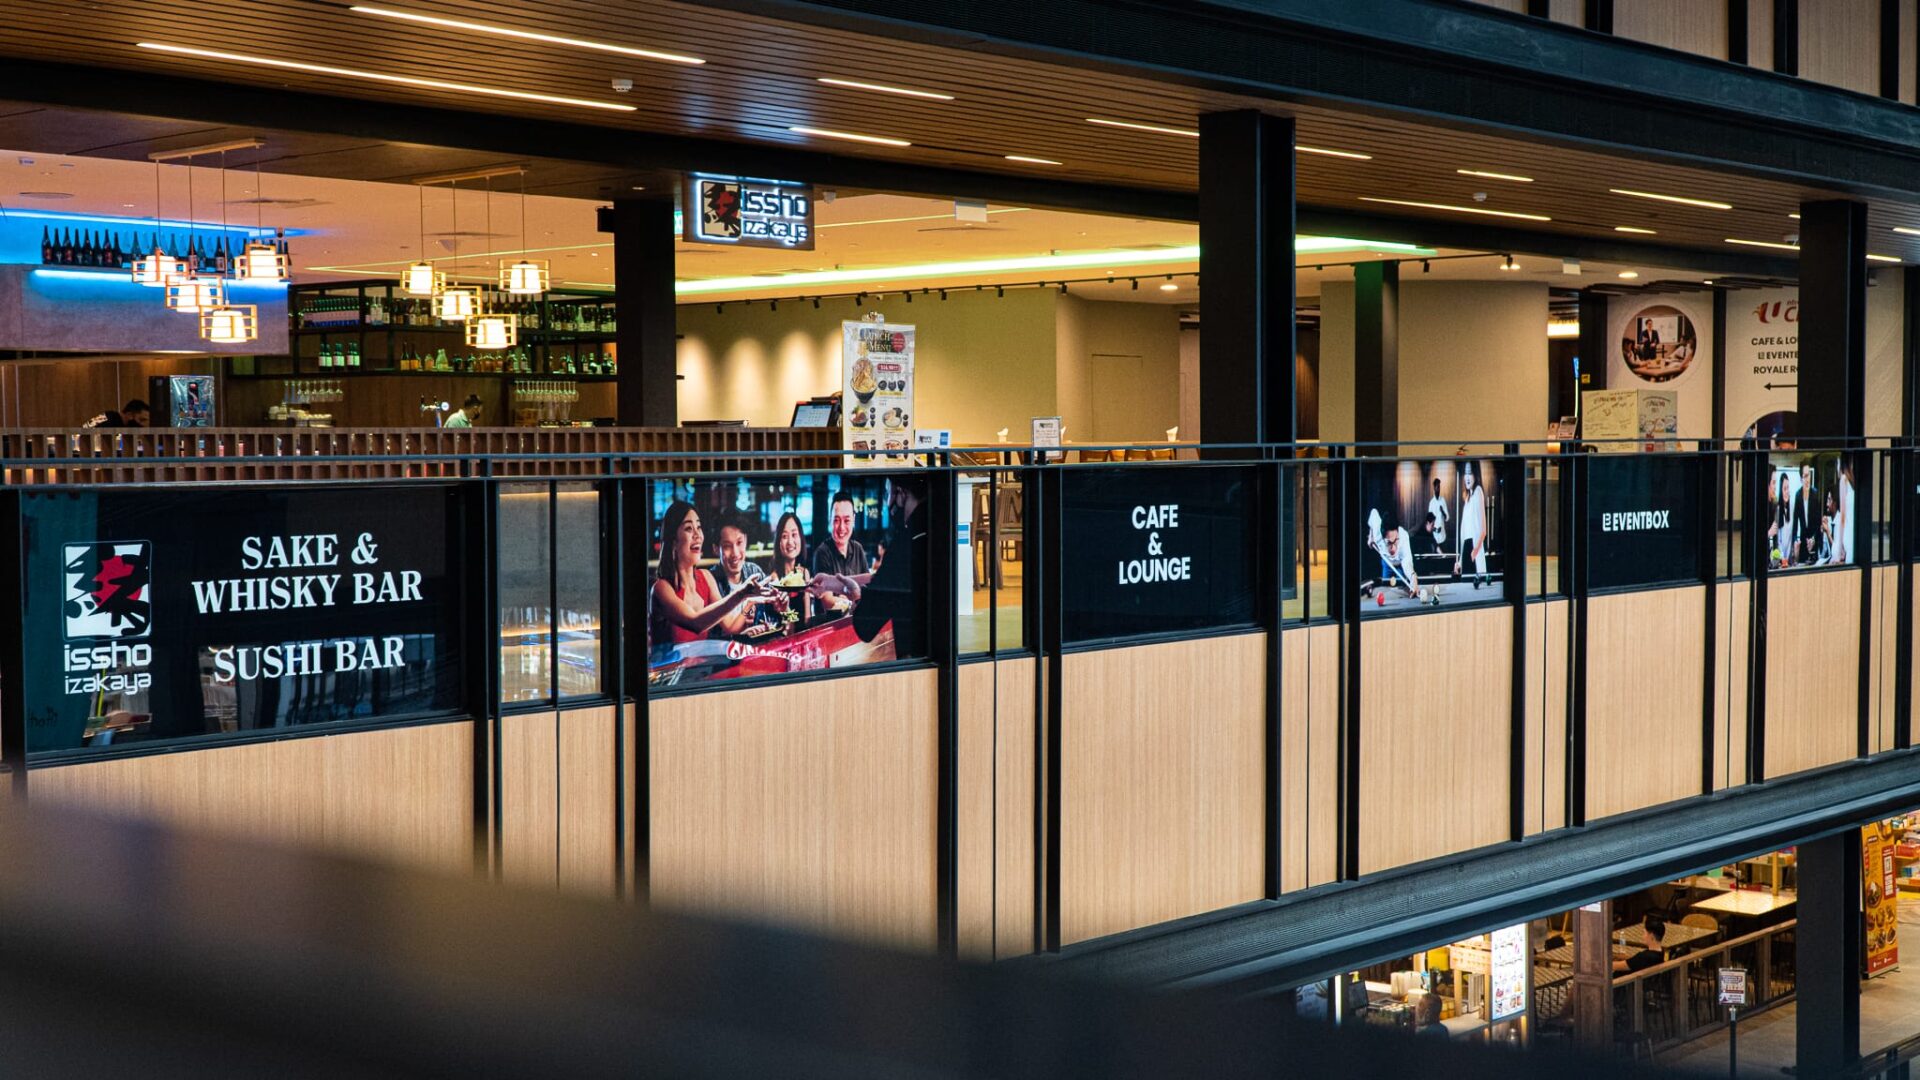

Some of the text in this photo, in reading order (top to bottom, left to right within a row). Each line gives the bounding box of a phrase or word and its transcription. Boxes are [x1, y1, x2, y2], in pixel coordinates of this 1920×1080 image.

[743, 185, 809, 218] issho
[743, 217, 809, 244] izakaya
[1751, 336, 1797, 345] CAFE & LO
[1753, 365, 1788, 374] ROYALE
[1132, 504, 1178, 529] CAFE
[1612, 510, 1670, 531] EVENTBOX
[242, 532, 378, 569] SAKE &
[1147, 532, 1163, 555] &
[1119, 557, 1191, 585] LOUNGE
[192, 570, 423, 614] WHISKY BAR
[64, 641, 152, 672] issho
[214, 637, 405, 682] SUSHI BAR
[65, 672, 152, 695] izakaya
